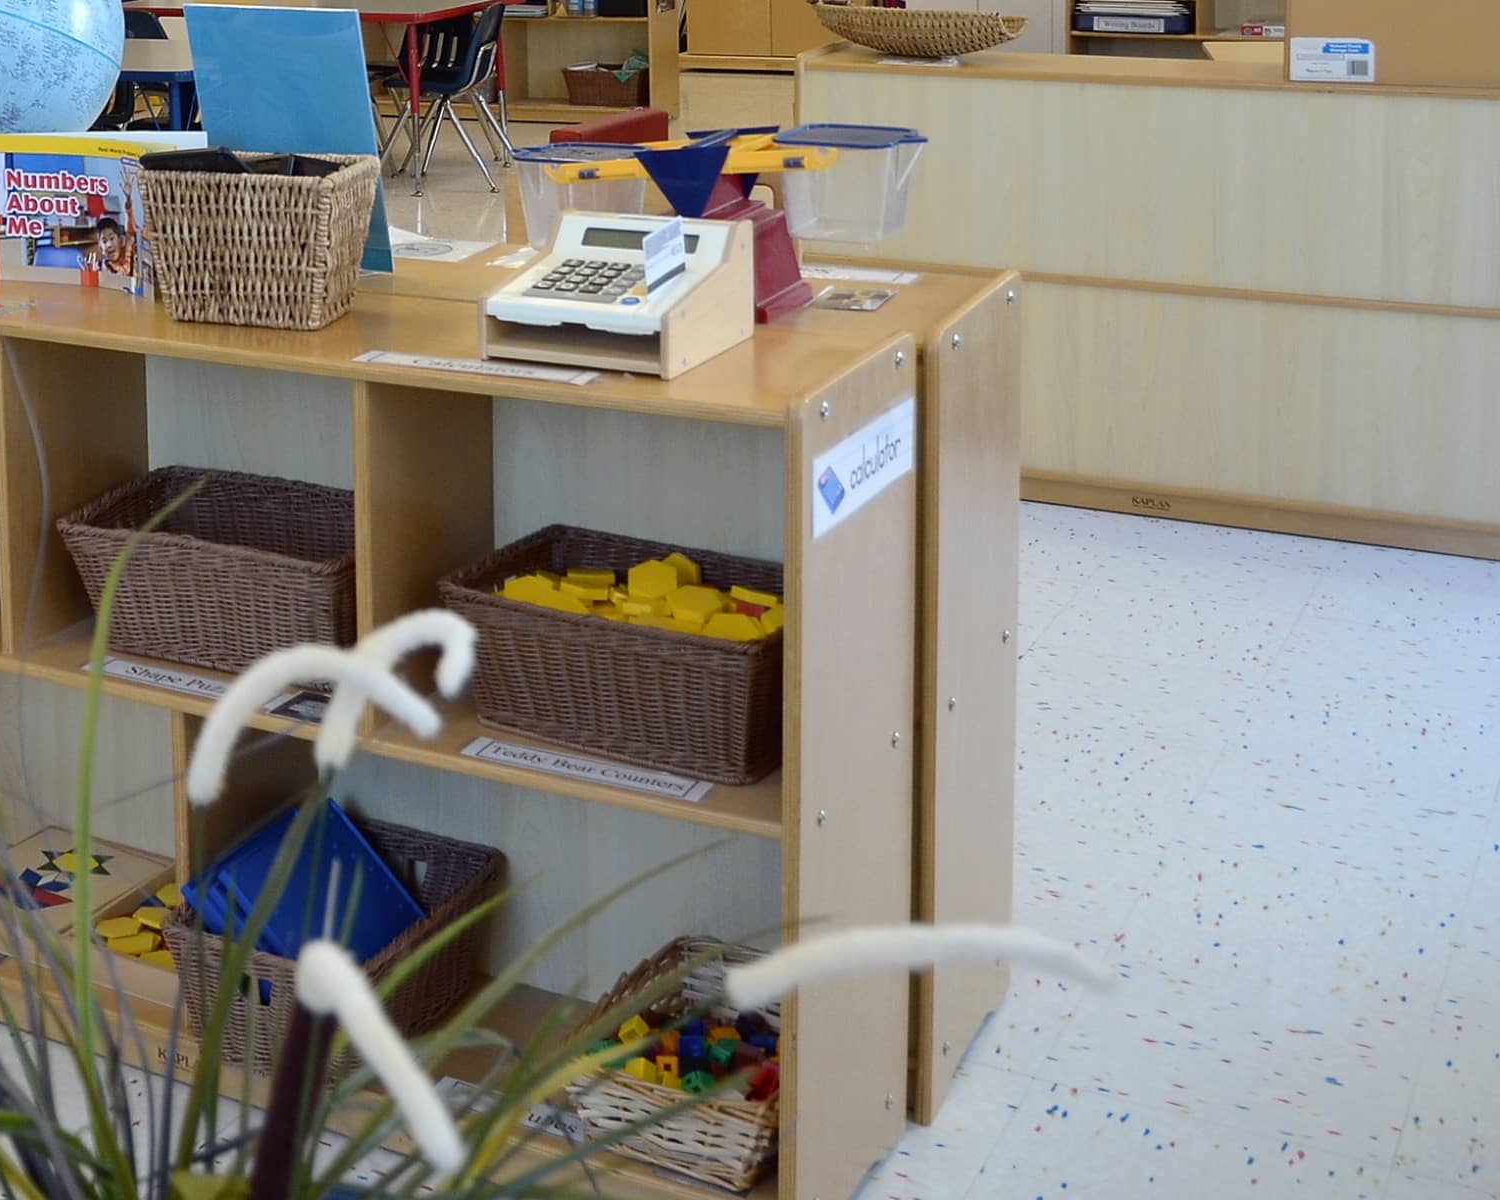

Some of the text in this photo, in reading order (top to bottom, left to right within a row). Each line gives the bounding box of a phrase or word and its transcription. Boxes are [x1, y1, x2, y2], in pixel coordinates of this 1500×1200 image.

[6, 171, 109, 194] Numbers
[7, 194, 79, 215] About
[7, 217, 43, 236] Me
[850, 434, 901, 489] calculator
[125, 663, 183, 685] Shape
[493, 746, 685, 792] Teddy Bear Counters
